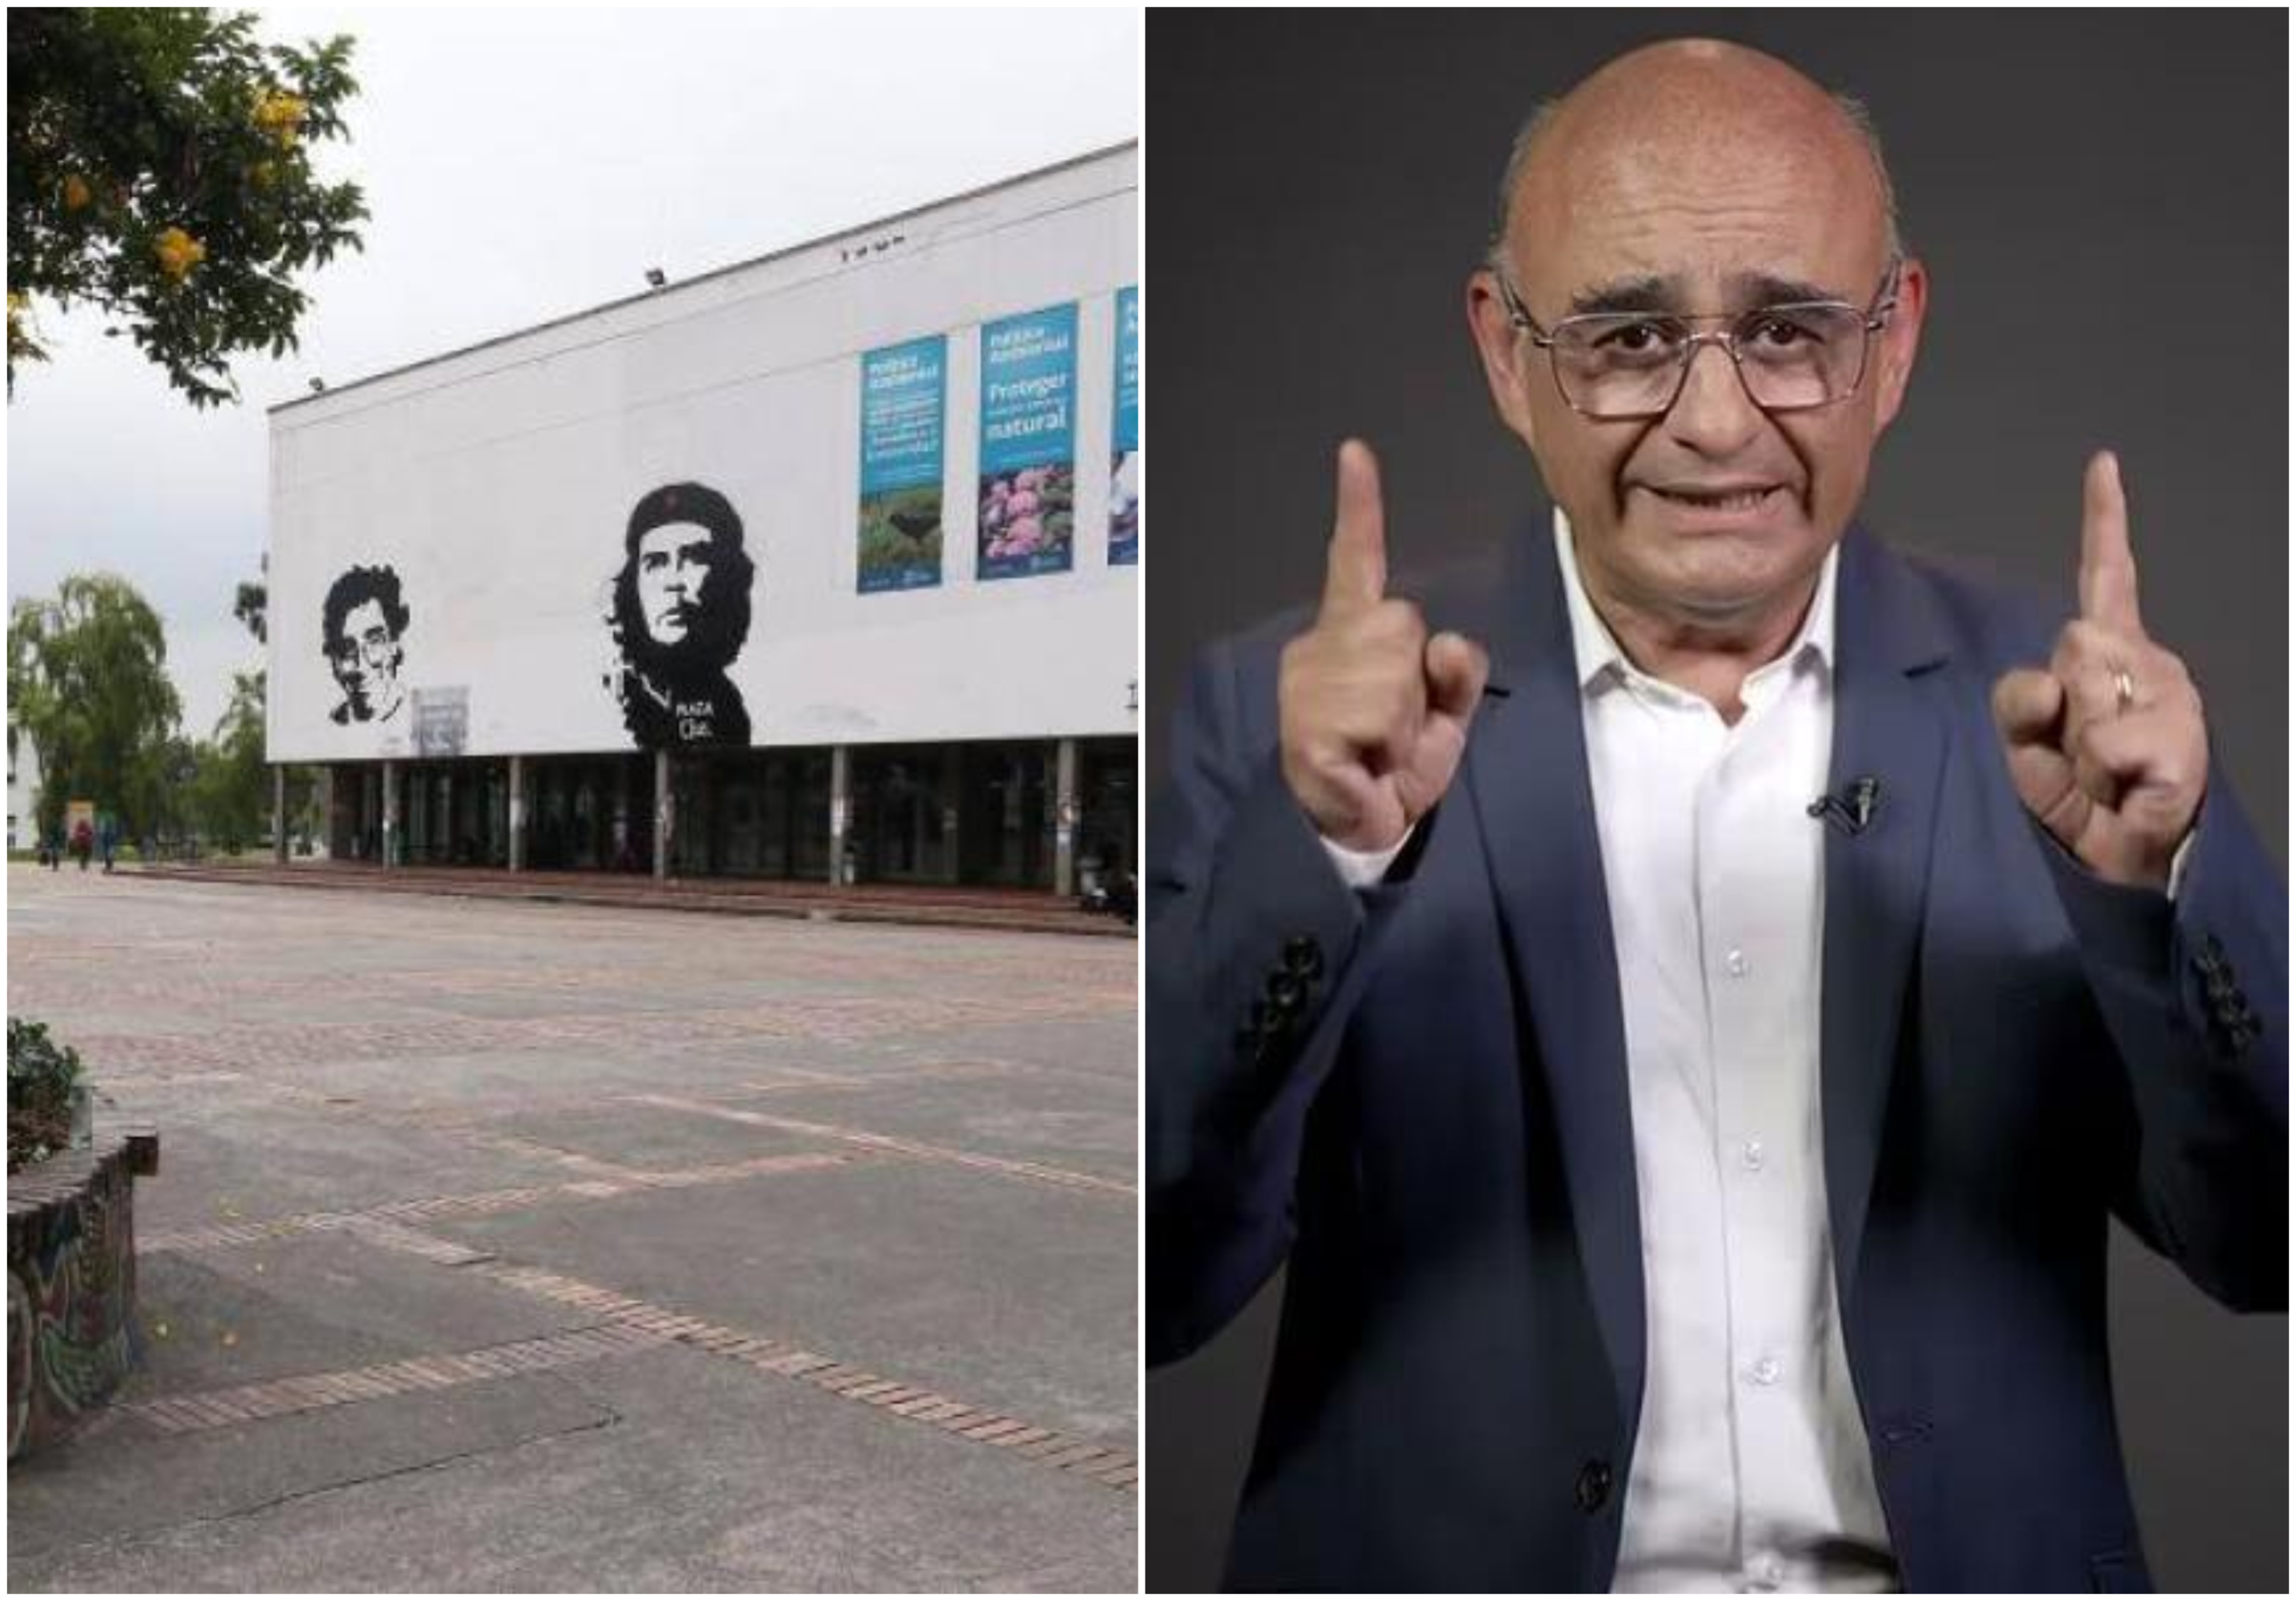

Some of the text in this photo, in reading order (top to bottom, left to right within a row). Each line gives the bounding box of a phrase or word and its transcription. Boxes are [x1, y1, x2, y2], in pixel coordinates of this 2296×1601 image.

[989, 372, 1067, 403] Proteger
[986, 404, 1066, 440] natural
[676, 700, 714, 718] PLAZA
